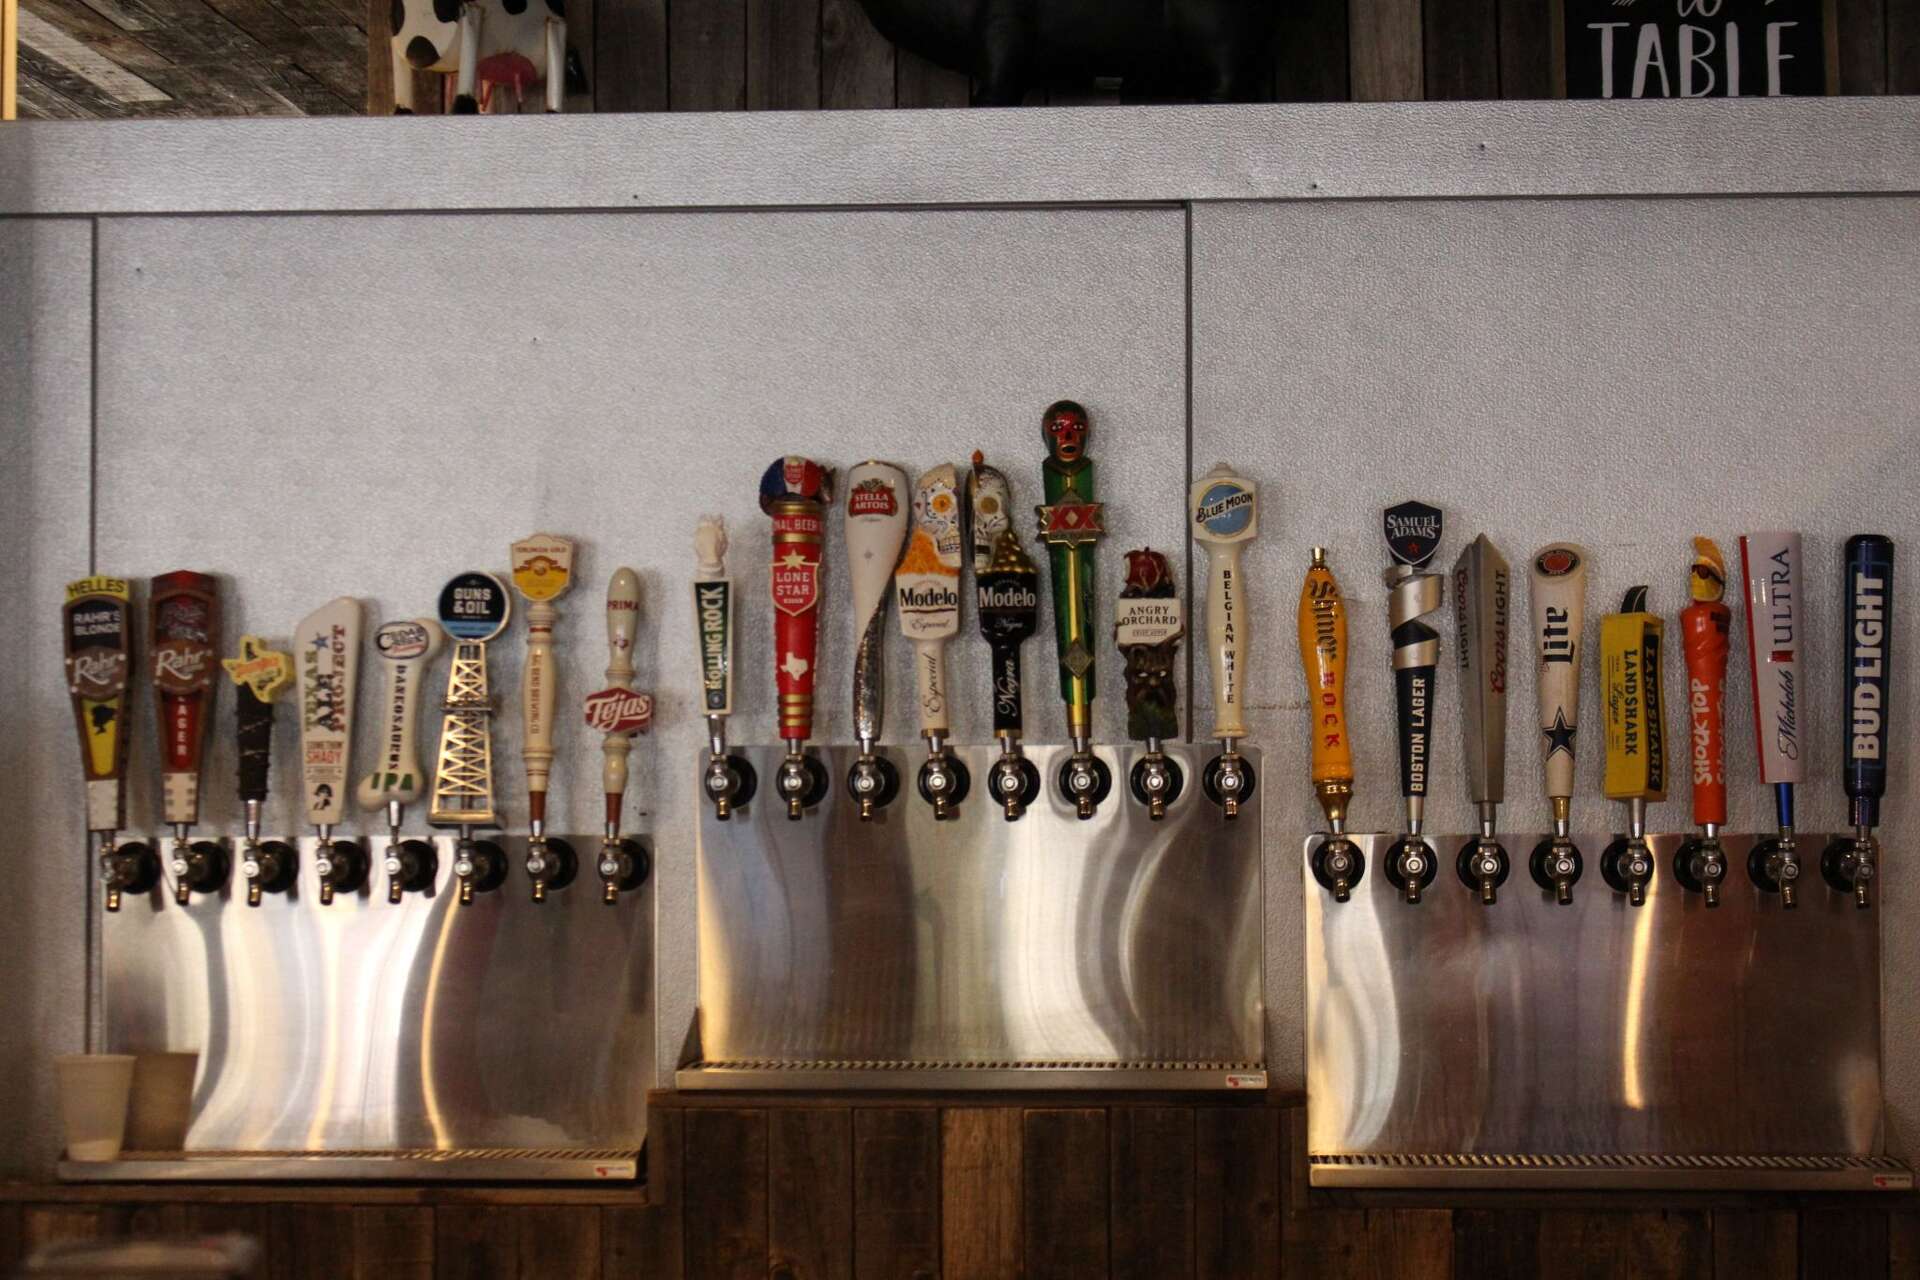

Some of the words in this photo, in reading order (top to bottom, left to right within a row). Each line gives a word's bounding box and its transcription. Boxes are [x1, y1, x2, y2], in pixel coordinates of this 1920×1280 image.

[854, 501, 889, 510] ARTOIS
[855, 493, 889, 501] STELLA
[1196, 502, 1224, 523] BLUE
[1225, 492, 1254, 509] MOON
[1386, 514, 1440, 529] SAMUEL
[1391, 526, 1436, 539] ADAMS
[67, 580, 125, 597] HELLES
[453, 587, 491, 601] GUNS
[776, 572, 809, 583] LONE
[776, 584, 809, 596] STAR
[900, 586, 957, 607] Modelo
[979, 586, 1035, 608] Modelo
[1496, 569, 1506, 627] LIGHT
[1770, 548, 1794, 645] ULTRA
[73, 611, 120, 623] RAHR'S
[73, 622, 120, 636] BLONDE
[701, 586, 724, 633] ROCK
[1122, 616, 1177, 625] ORCHARD
[1129, 606, 1169, 616] ANGRY
[1223, 570, 1233, 643] BELGIAN
[1855, 572, 1883, 678] LIGHT
[1460, 623, 1469, 669] LIGHT
[1543, 606, 1575, 665] Lite
[75, 652, 118, 685] Rahr
[156, 648, 204, 680] Rahr
[332, 625, 345, 733] PROJECT
[704, 633, 723, 690] ROLLING
[1225, 650, 1235, 704] WHITE
[305, 651, 318, 732] TEXAS
[317, 674, 335, 732] ALE
[585, 693, 650, 731] Tejas
[1322, 671, 1340, 748] BOCK
[1411, 678, 1425, 728] LAGER
[1624, 649, 1638, 756] LANDSHARK
[1645, 645, 1661, 784] LANDSHARK
[1691, 678, 1710, 718] TOP
[388, 665, 408, 770] DANKOSAURUS
[1777, 669, 1799, 761] Michelob
[1852, 682, 1881, 759] BUD
[1410, 733, 1424, 793] BOSTON
[1694, 718, 1712, 786] SHOCK
[371, 772, 413, 792] IPA
